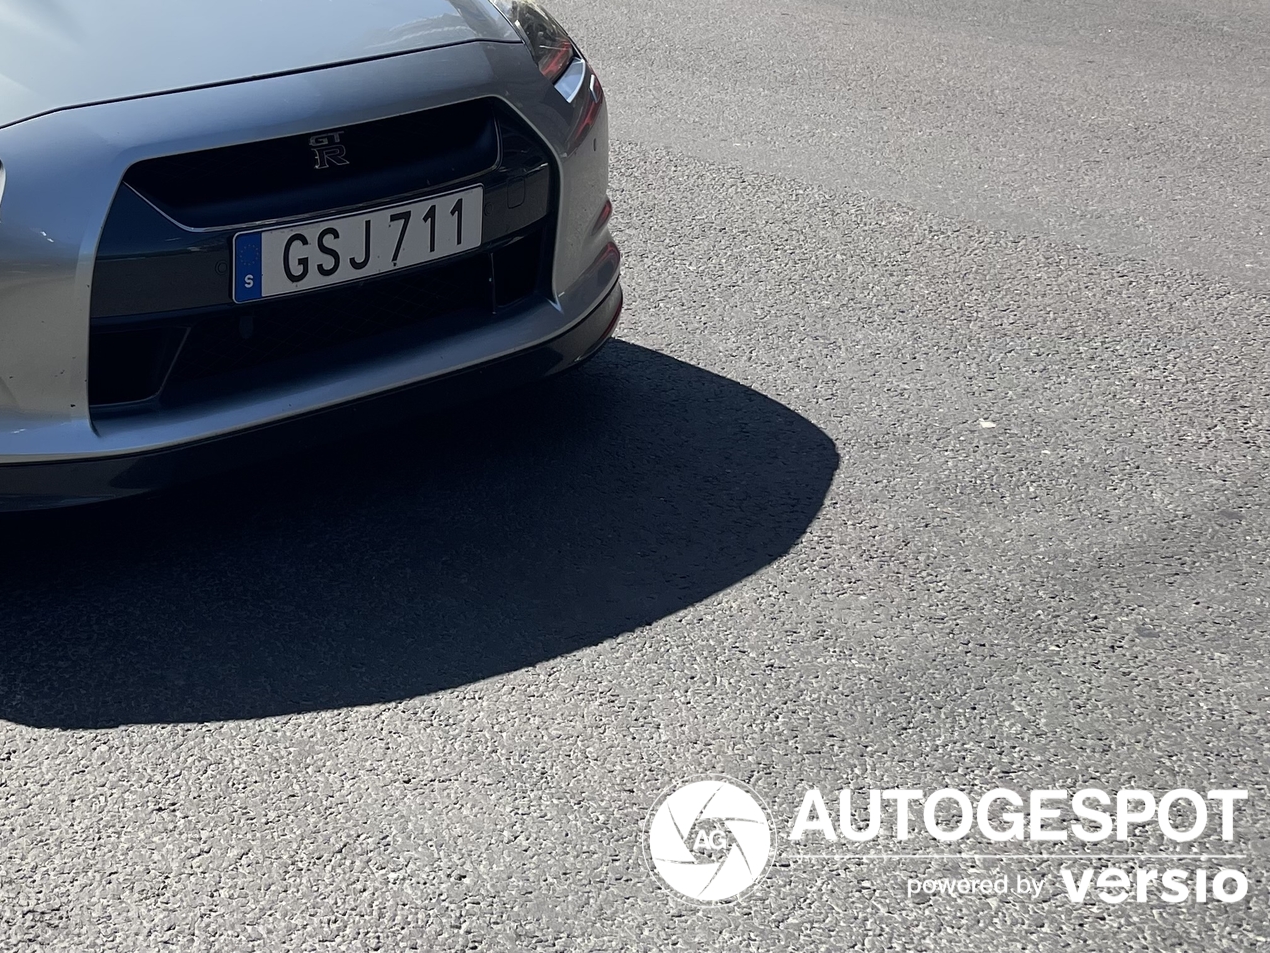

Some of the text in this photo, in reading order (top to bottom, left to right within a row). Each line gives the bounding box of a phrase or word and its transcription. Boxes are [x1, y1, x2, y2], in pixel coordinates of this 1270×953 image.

[283, 198, 463, 283] GSJ 711
[244, 274, 254, 288] S
